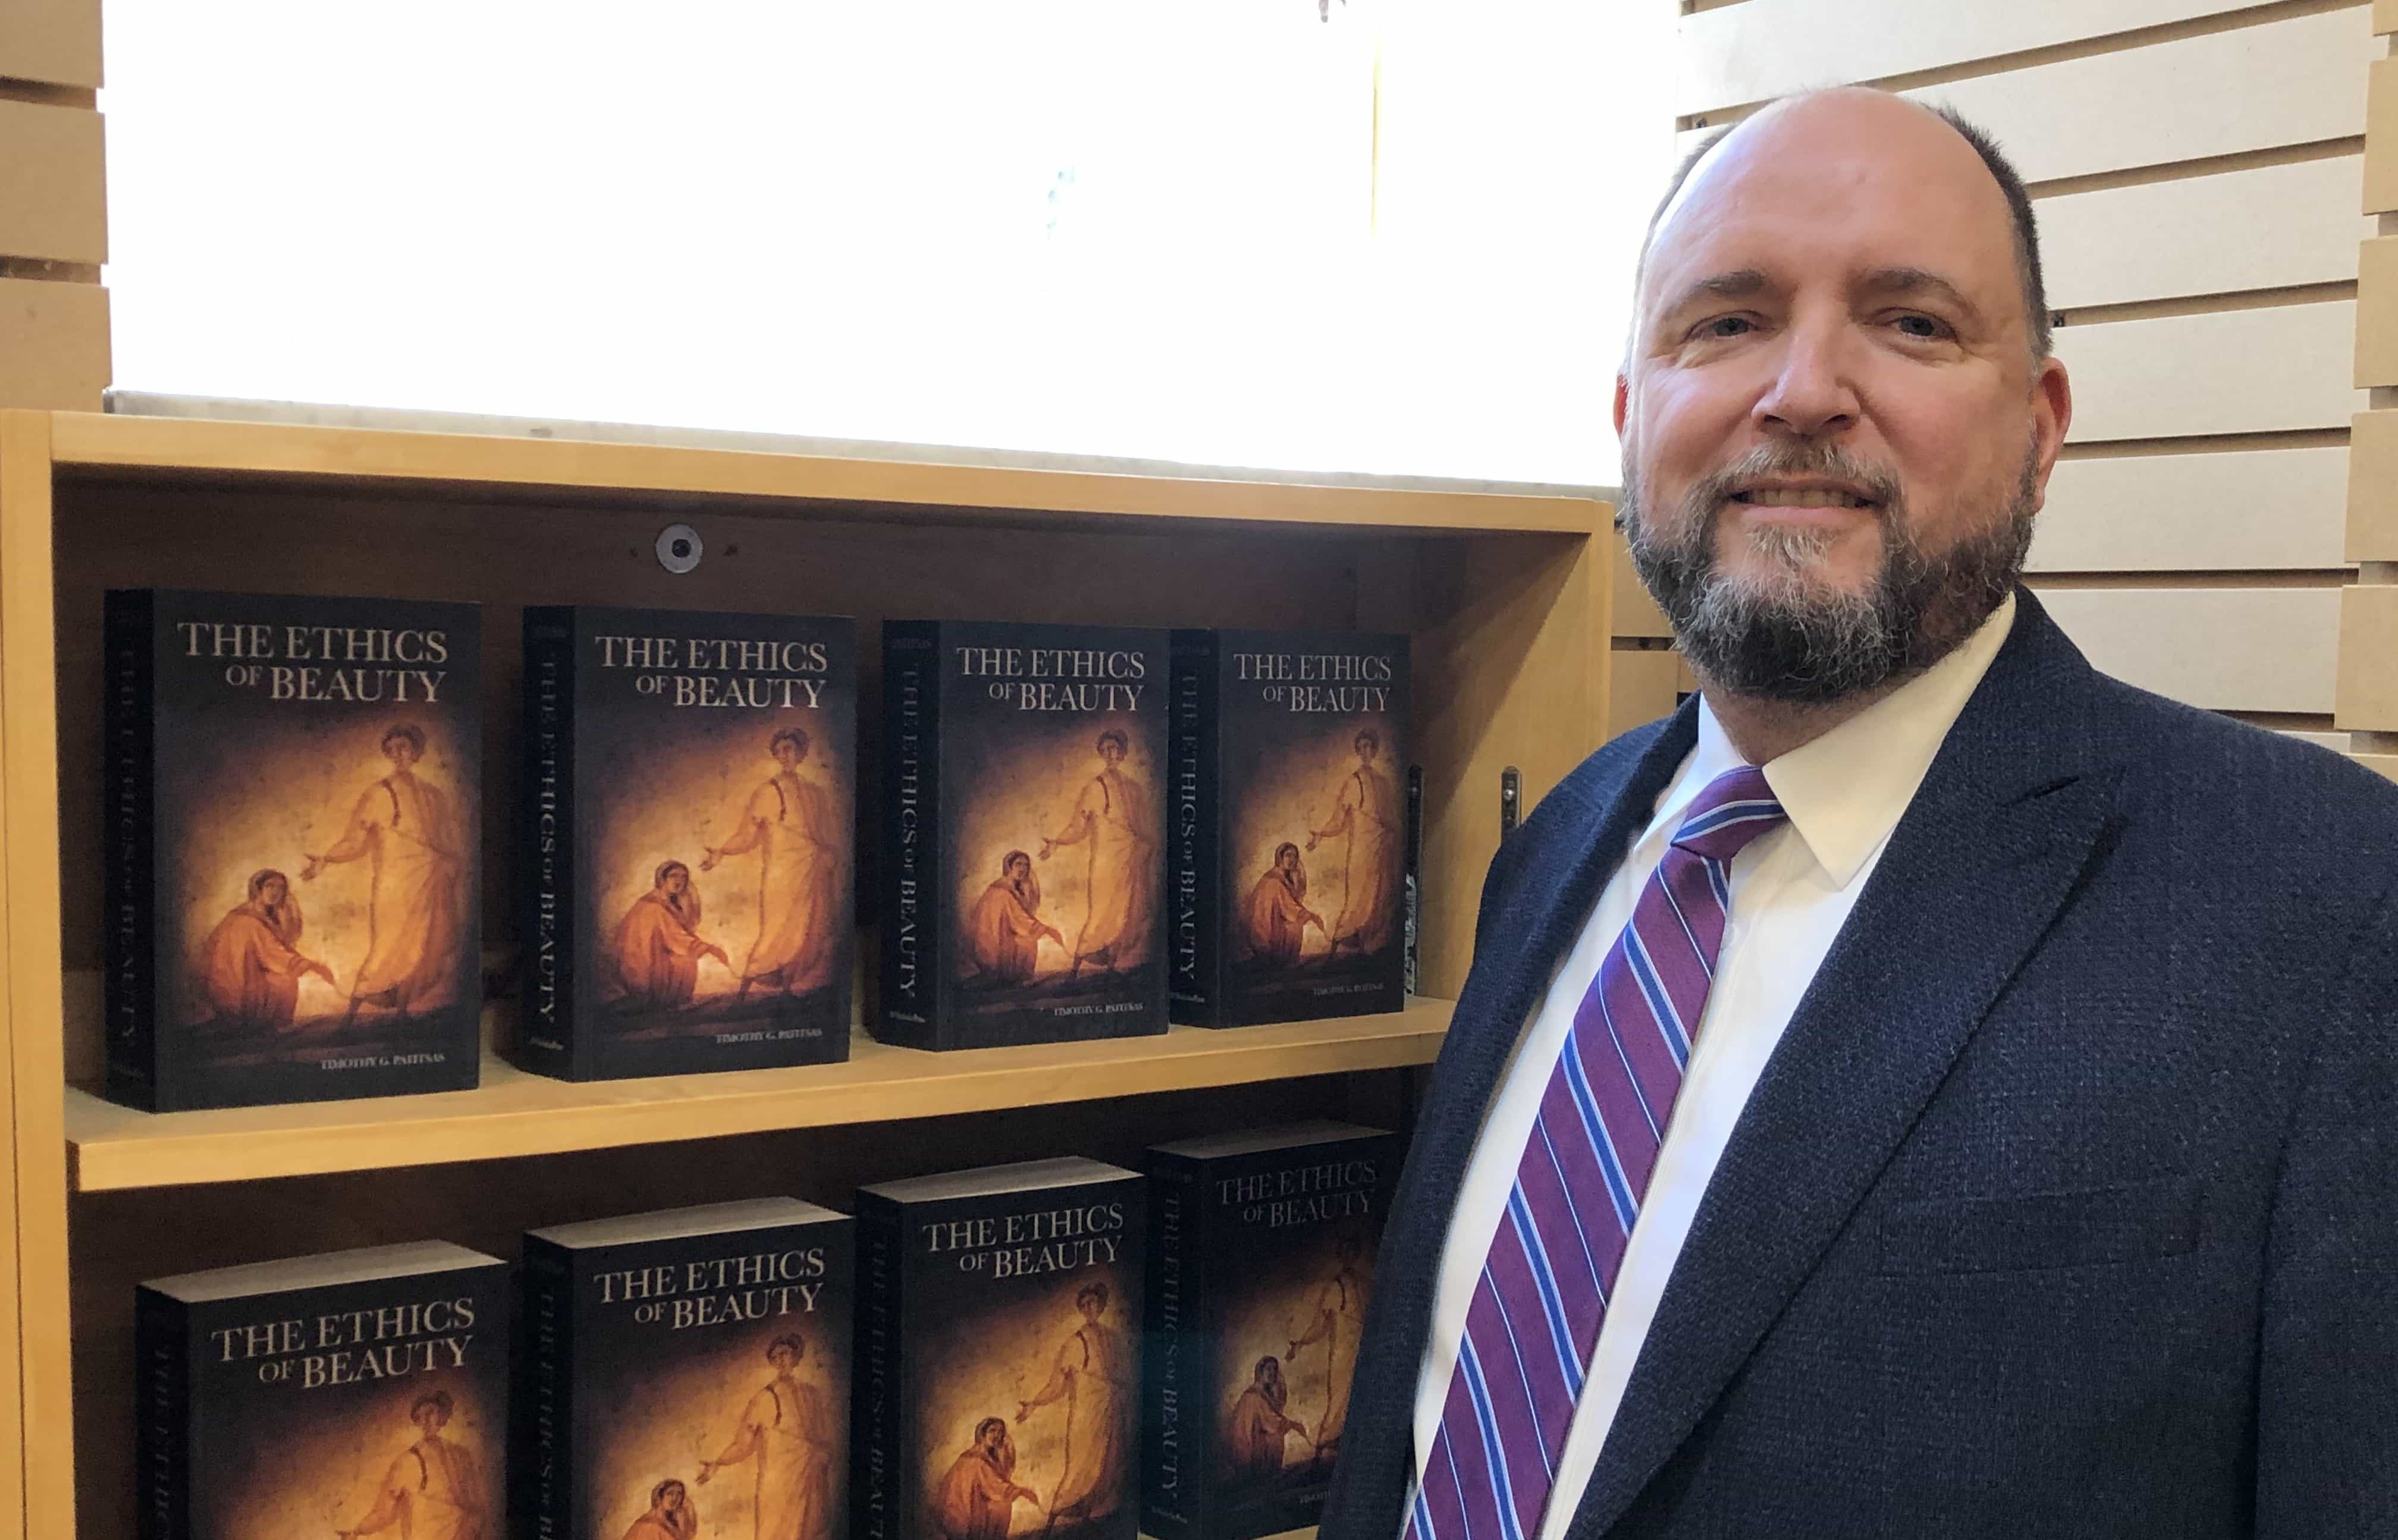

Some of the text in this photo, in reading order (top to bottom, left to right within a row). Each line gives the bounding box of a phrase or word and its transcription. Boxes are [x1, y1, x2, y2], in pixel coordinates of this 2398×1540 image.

[177, 622, 448, 664] THE ETHICS
[595, 636, 827, 672] THE ETHICS
[956, 648, 1145, 678] THE ETHICS
[225, 665, 447, 703] OF BEAUTY
[1233, 654, 1392, 681] THE ETHICS
[636, 675, 827, 709] OF BEAUTY
[988, 681, 1144, 712] OF BEAUTY
[1263, 686, 1391, 712] OF BEAUTY
[900, 879, 916, 998] BEAUTY
[1180, 870, 1197, 979] BEAUTY
[540, 892, 554, 1023] BEAUTY
[1216, 1172, 1274, 1205] THE
[1278, 1159, 1378, 1198] ETHICS
[922, 1203, 1124, 1252] THE ETHICS
[1243, 1189, 1377, 1228] OF BEAUTY
[594, 1248, 826, 1303] THE ETHICS
[959, 1235, 1123, 1279] OF BEAUTY
[634, 1283, 824, 1330] OF BEAUTY
[211, 1297, 476, 1362] THE ETHICS
[258, 1335, 473, 1390] OF BEAUTY
